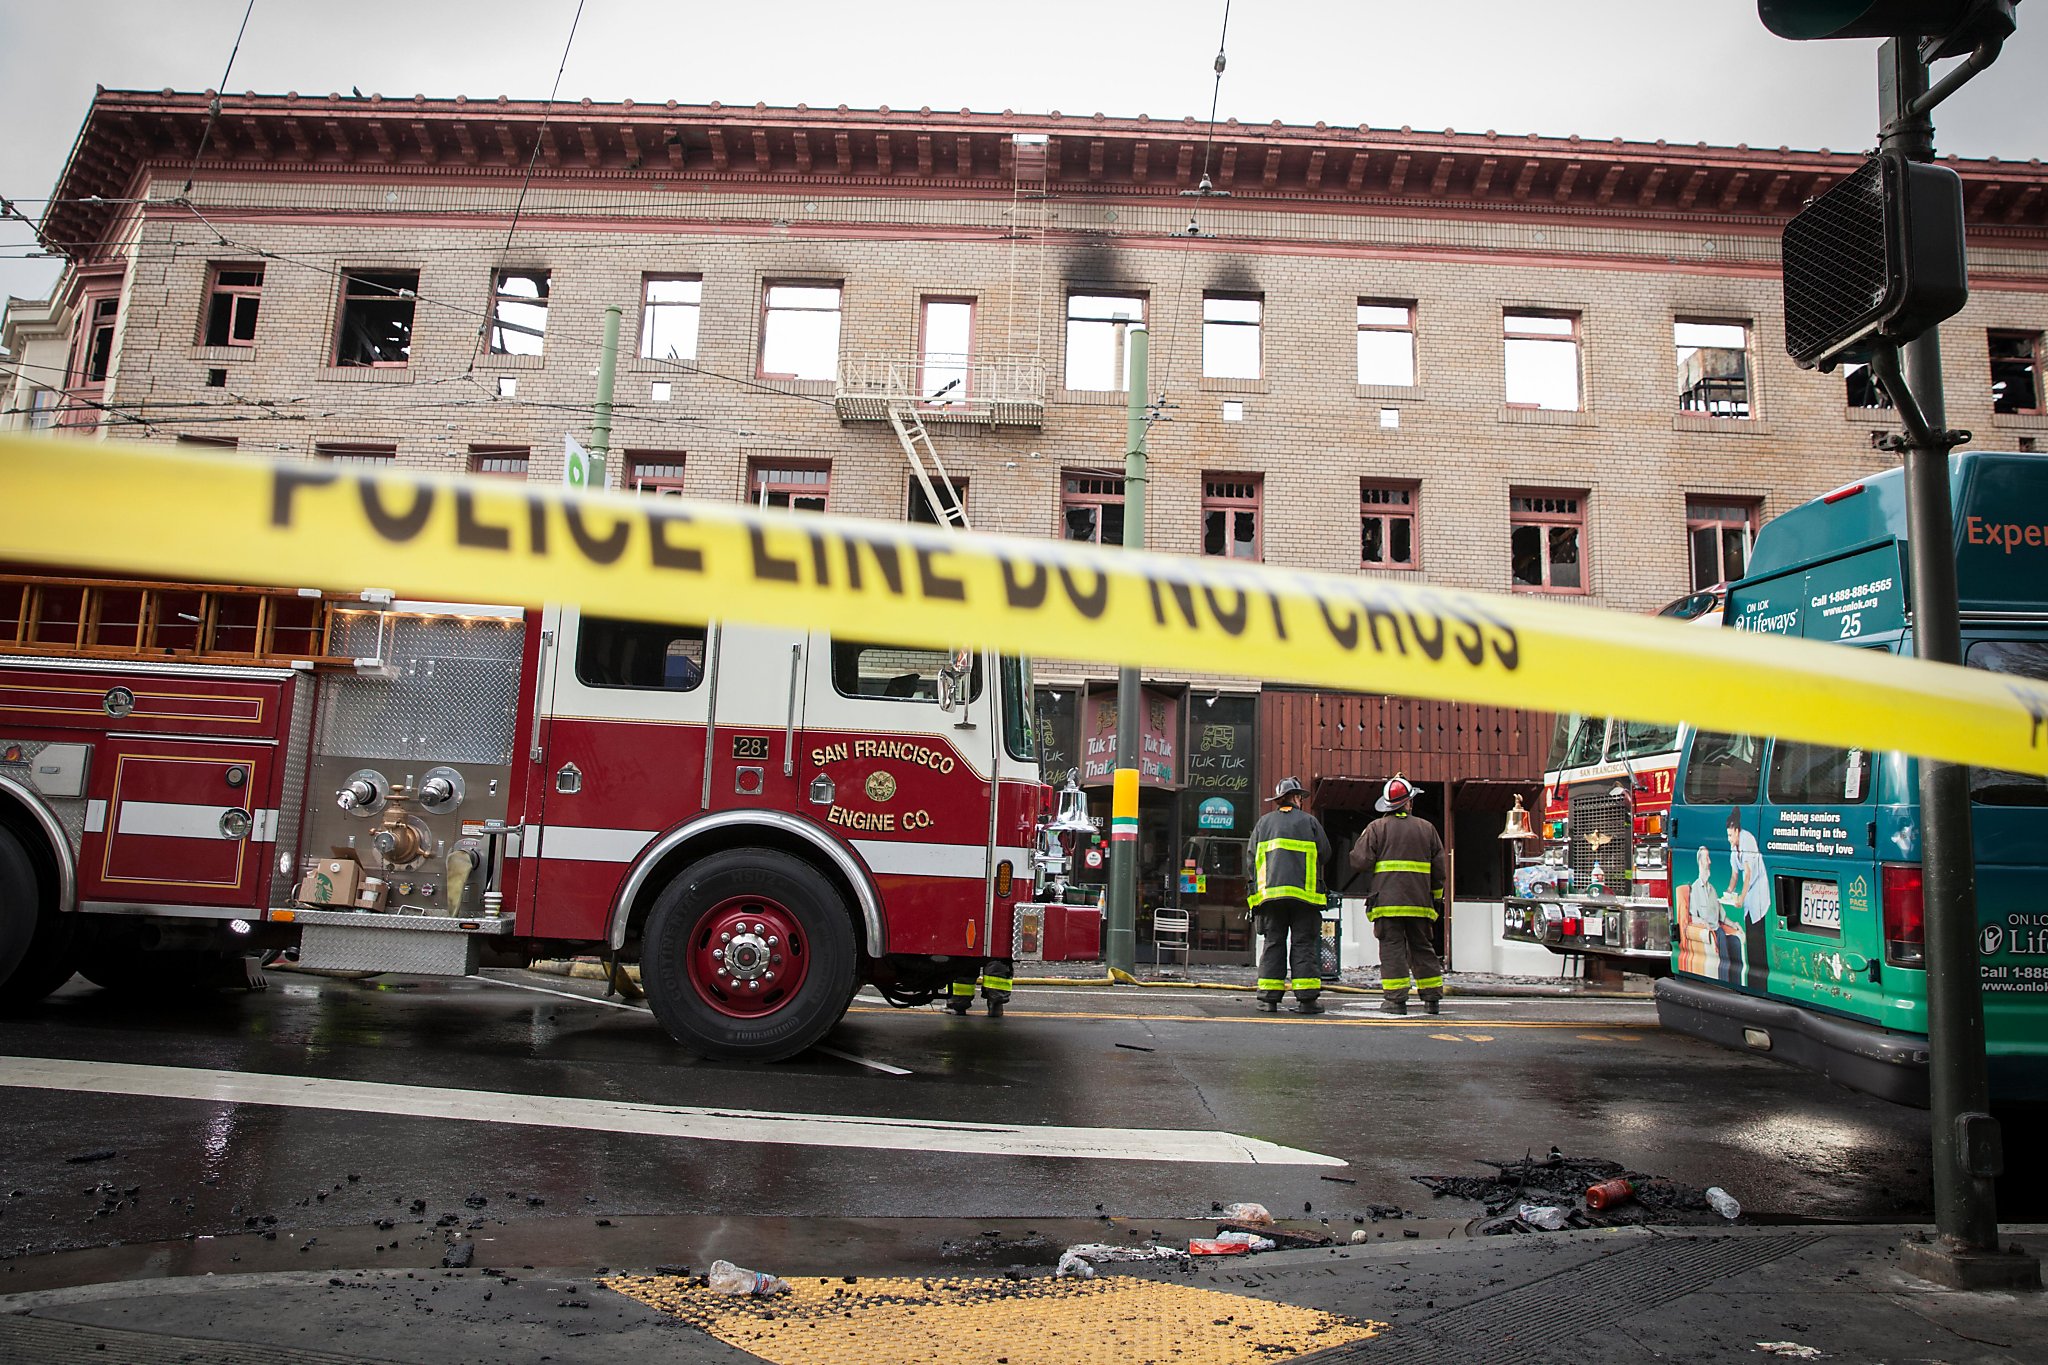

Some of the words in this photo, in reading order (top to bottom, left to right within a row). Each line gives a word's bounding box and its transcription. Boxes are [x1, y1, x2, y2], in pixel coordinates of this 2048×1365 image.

[270, 462, 704, 572] POLICE
[746, 516, 967, 602] LINE
[994, 546, 1108, 619] DO
[1296, 578, 1520, 671] CROSS
[1811, 594, 1828, 608] Call
[1829, 578, 1892, 603] 1-888-886-6565
[1746, 604, 1757, 614] ON
[1758, 600, 1769, 610] LOK
[1823, 597, 1878, 617] www.onlok.org
[1840, 613, 1861, 638] 25
[738, 738, 761, 756] 28
[1088, 737, 1105, 756] Tuk
[1107, 734, 1116, 752] Tu
[1144, 733, 1157, 753] Tuk
[1159, 737, 1171, 757] Tuk
[811, 742, 849, 767] SAN
[854, 740, 955, 774] FRANCISCO
[1189, 753, 1215, 768] Tuk
[1220, 754, 1245, 769] Tuk
[1580, 768, 1590, 777] SAN
[1593, 764, 1624, 775] FRANCISCO
[1655, 771, 1670, 793] T2
[827, 804, 895, 831] ENGINE
[902, 809, 934, 830] CO.
[1200, 814, 1233, 826] Chang
[1780, 812, 1808, 823] Helping
[1810, 813, 1840, 822] seniors
[1773, 827, 1798, 836] remain
[1800, 827, 1821, 839] living
[1823, 828, 1831, 837] in
[1833, 828, 1847, 838] the
[1767, 842, 1815, 852] communities
[1816, 843, 1834, 855] they
[1836, 844, 1854, 854] love
[2008, 913, 2029, 925] ON
[2008, 928, 2048, 954] Lif
[1980, 966, 2007, 978] Call
